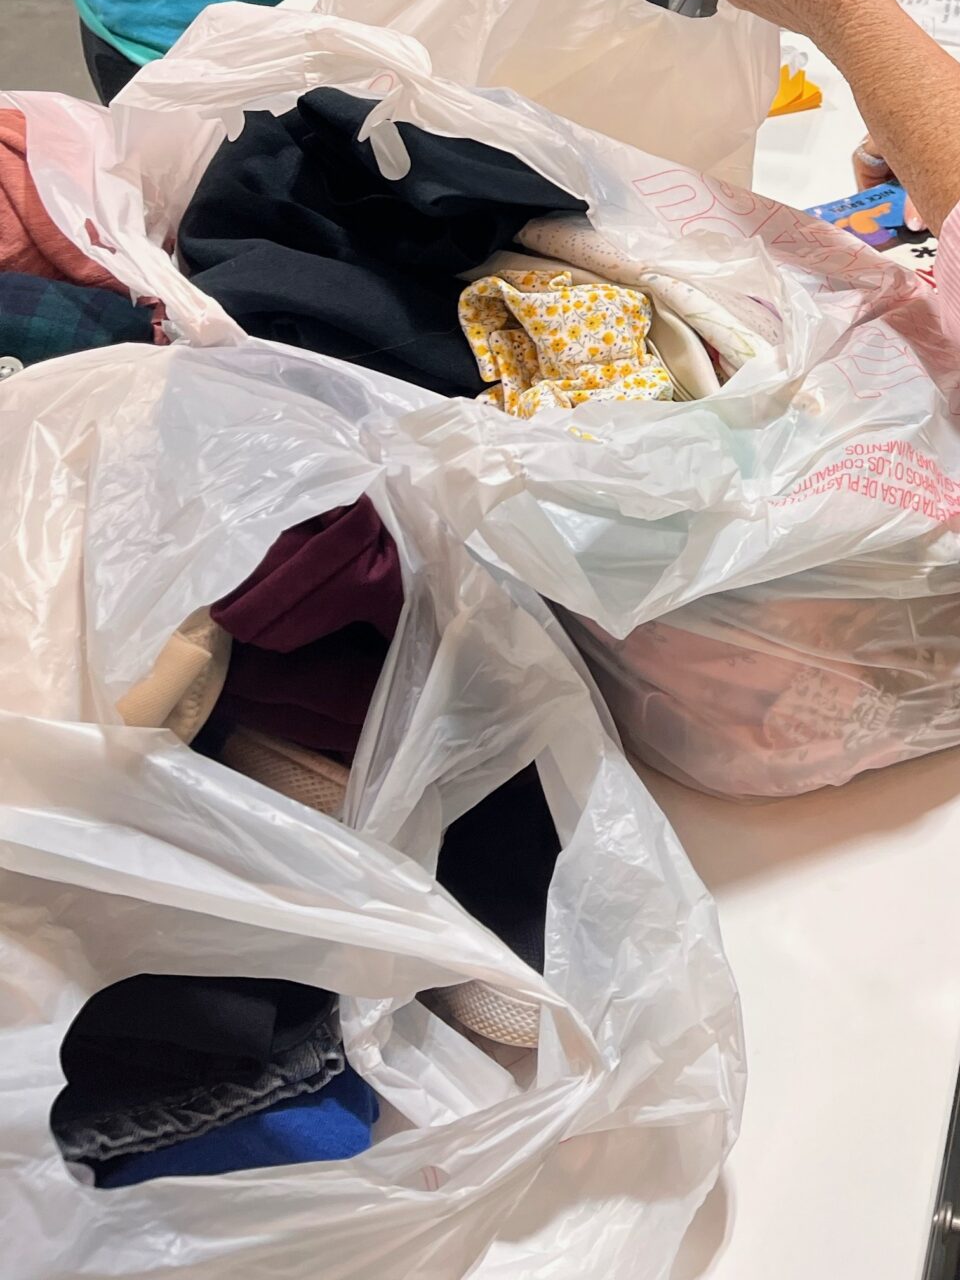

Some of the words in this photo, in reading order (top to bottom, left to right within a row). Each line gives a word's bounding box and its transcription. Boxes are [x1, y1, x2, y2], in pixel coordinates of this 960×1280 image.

[865, 189, 896, 203] NICK
[867, 456, 891, 478] LOS
[895, 463, 904, 481] O
[861, 477, 878, 499] DE
[883, 484, 921, 512] BOLSA
